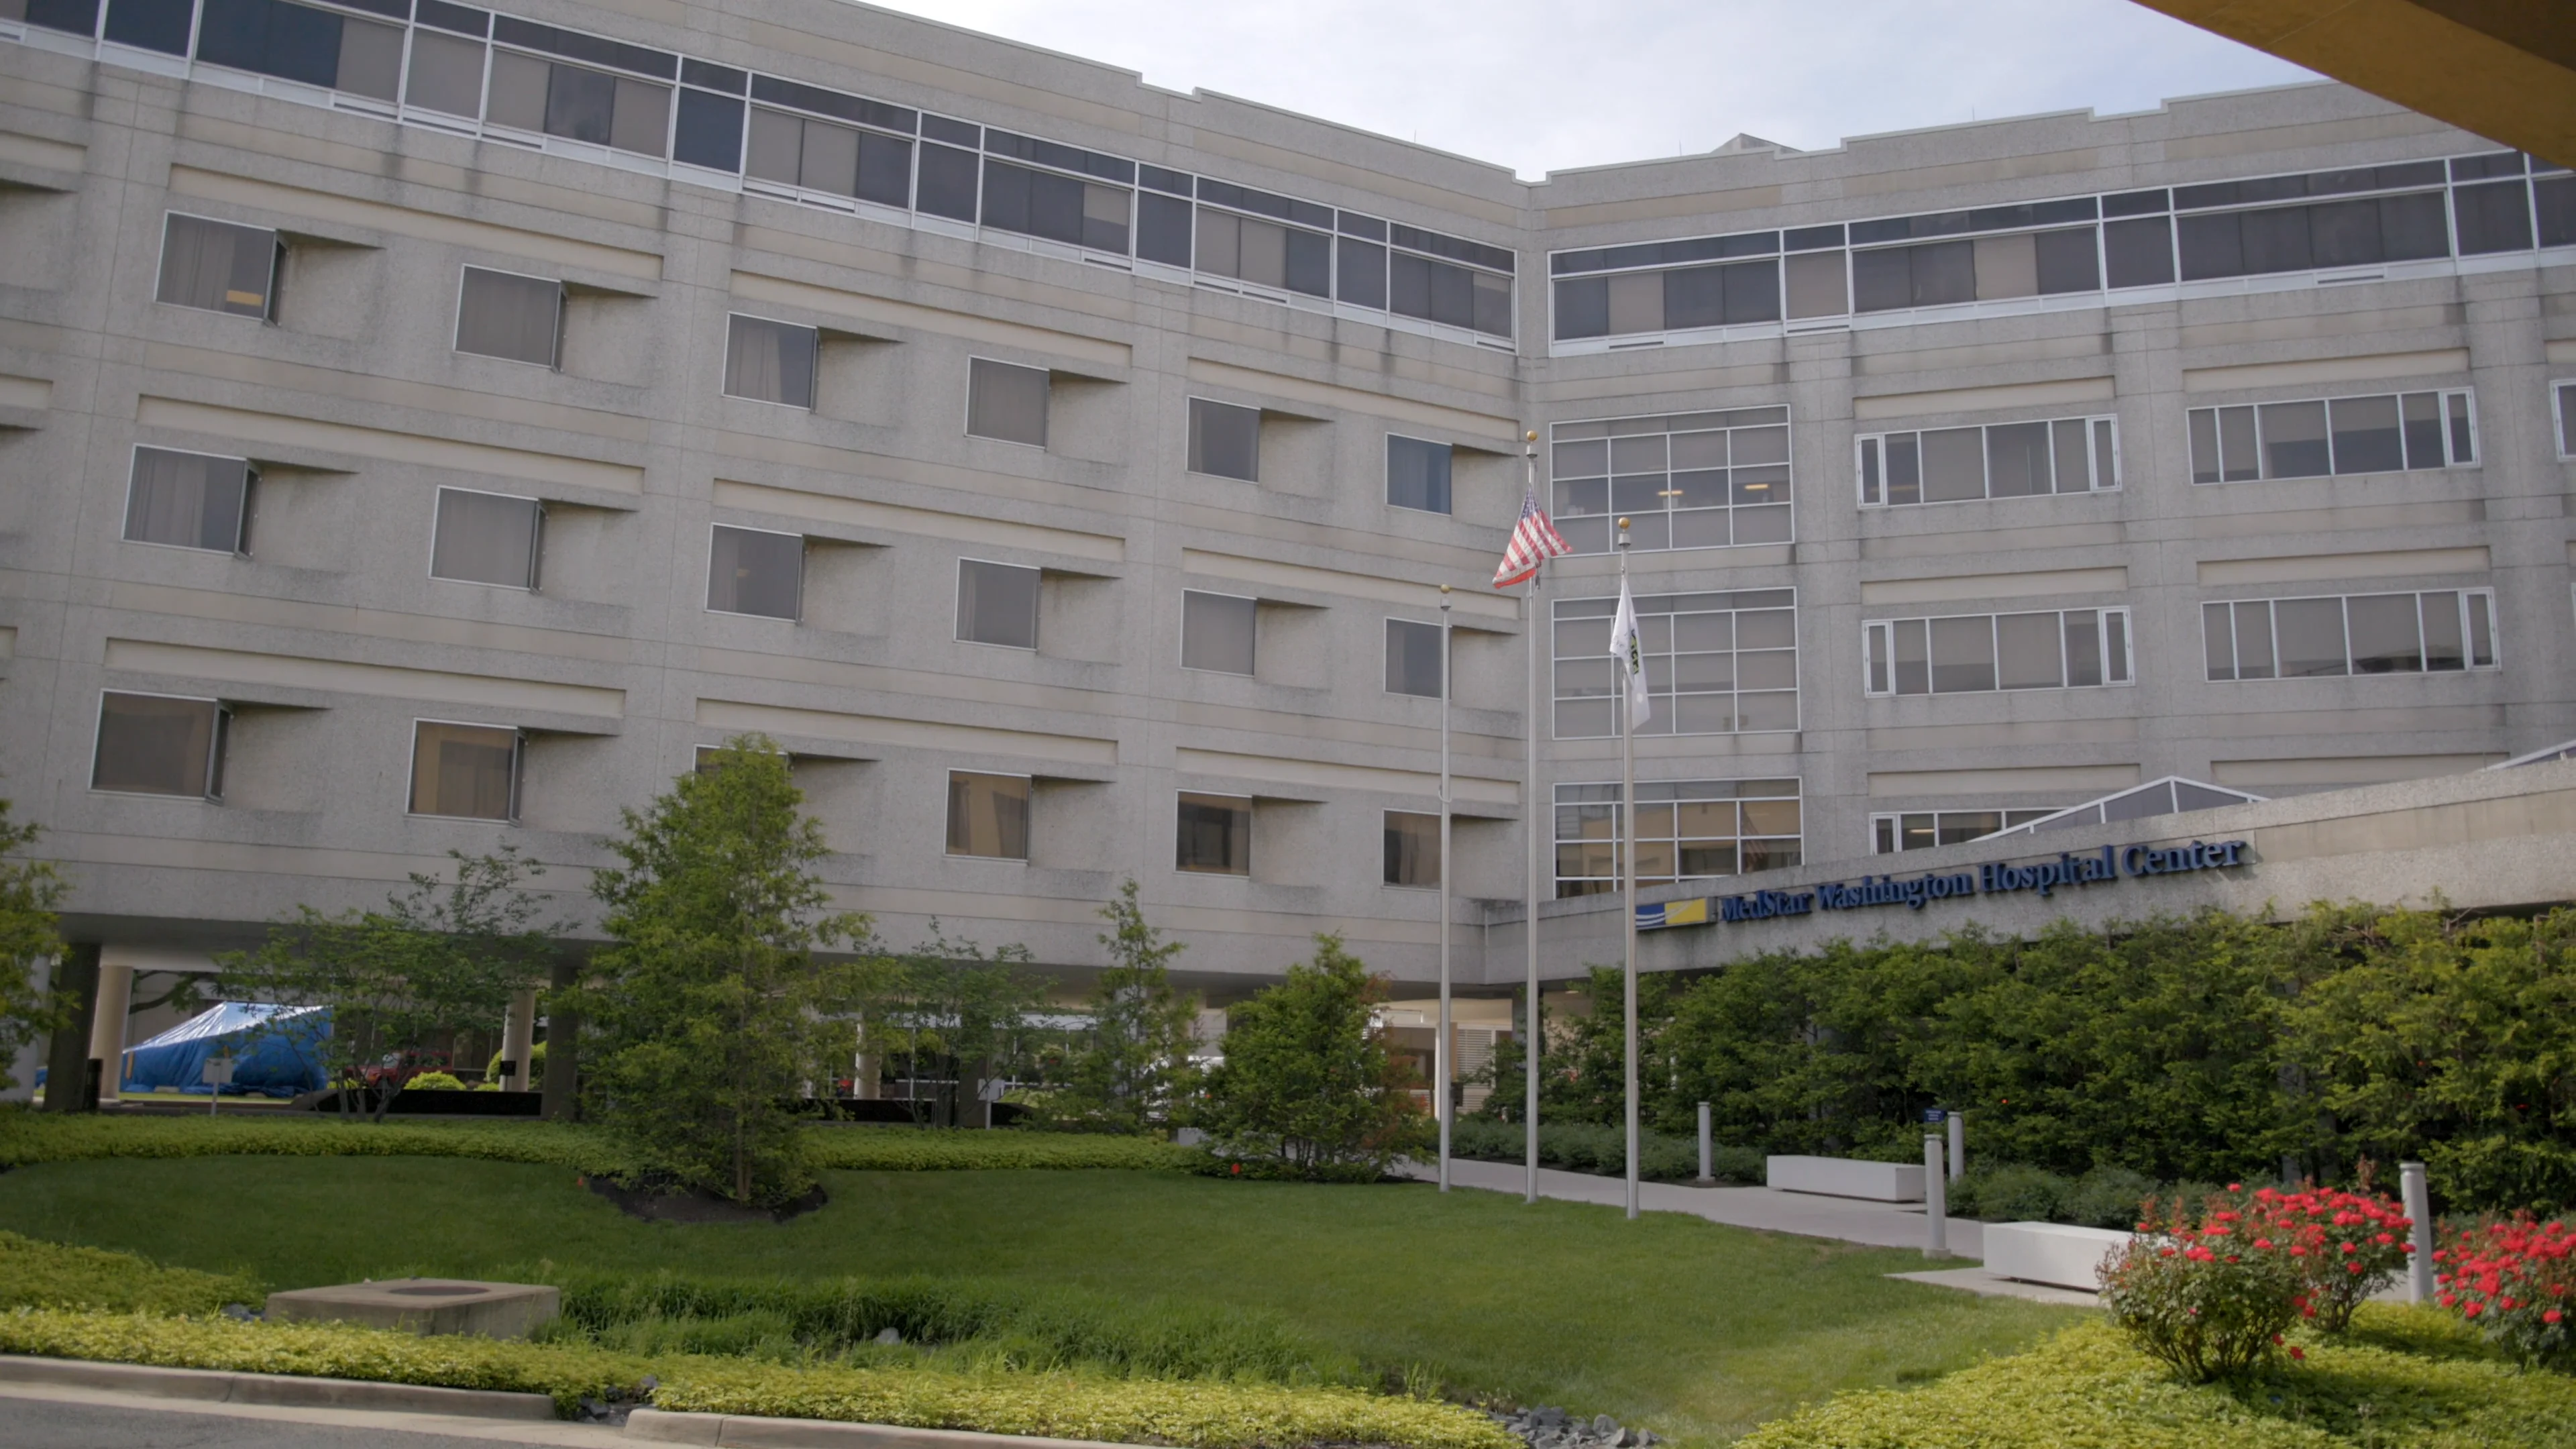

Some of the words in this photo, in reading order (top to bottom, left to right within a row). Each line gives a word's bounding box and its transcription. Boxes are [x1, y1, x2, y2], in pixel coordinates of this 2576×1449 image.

[1721, 890, 1814, 923] MedStar
[1815, 873, 1974, 910] Washington
[1978, 845, 2118, 896] Hospital
[2121, 839, 2247, 877] Center
